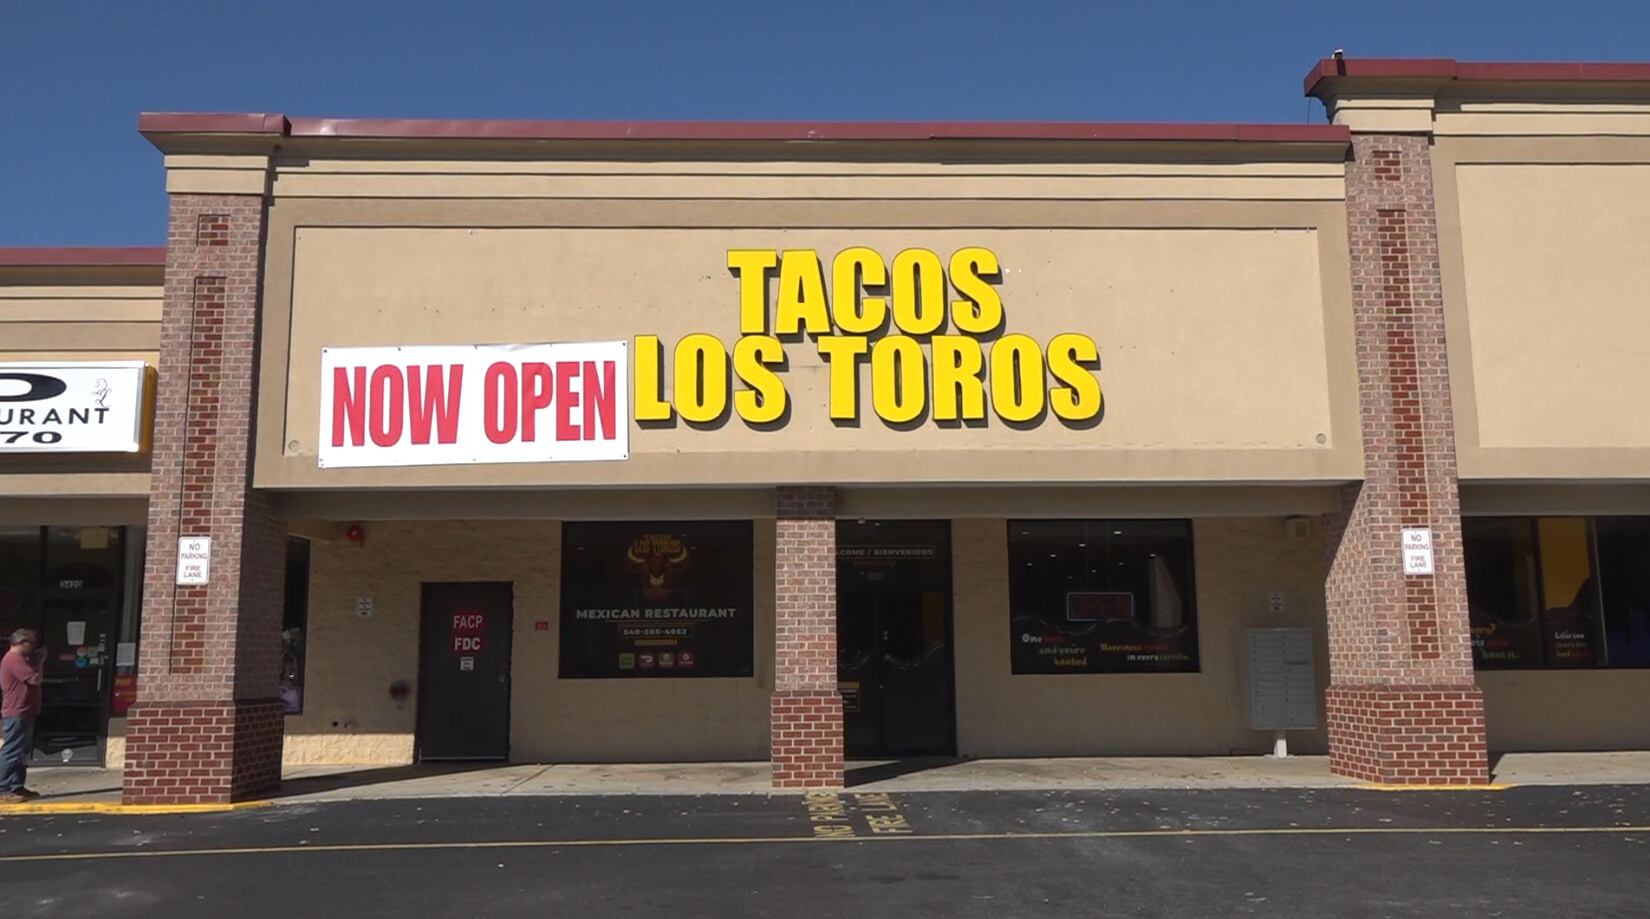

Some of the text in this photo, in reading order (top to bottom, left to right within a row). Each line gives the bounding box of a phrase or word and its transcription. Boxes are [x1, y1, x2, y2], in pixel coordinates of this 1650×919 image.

[727, 246, 1002, 334] TACOS
[634, 332, 1101, 424] LOS TOROS
[332, 361, 616, 447] NOW OPEN
[1410, 534, 1422, 542] NO
[188, 543, 202, 551] NO
[1404, 543, 1430, 551] PARKING
[180, 552, 208, 560] PARKING
[575, 607, 737, 620] MEXICAN RESTAURANT
[453, 614, 483, 630] FACP
[454, 637, 481, 651] FDC
[1021, 633, 1042, 644] One
